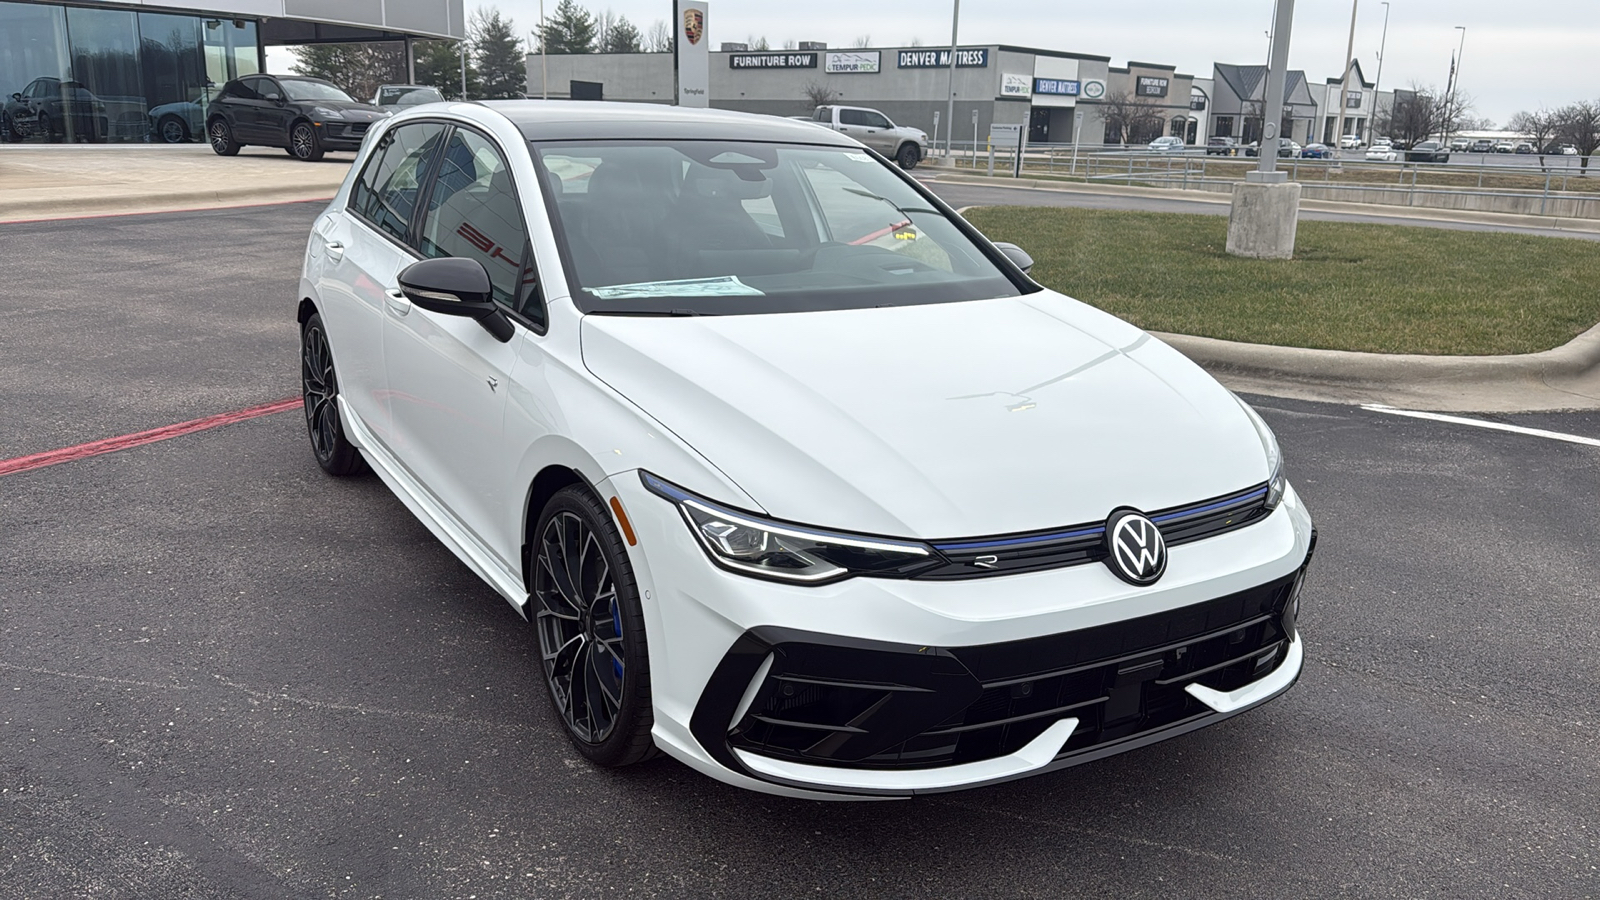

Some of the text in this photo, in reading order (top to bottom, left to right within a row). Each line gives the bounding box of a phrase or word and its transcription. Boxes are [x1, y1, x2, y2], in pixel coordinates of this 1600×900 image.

[733, 55, 811, 67] FURNITURE ROW
[900, 52, 937, 66] DENVER
